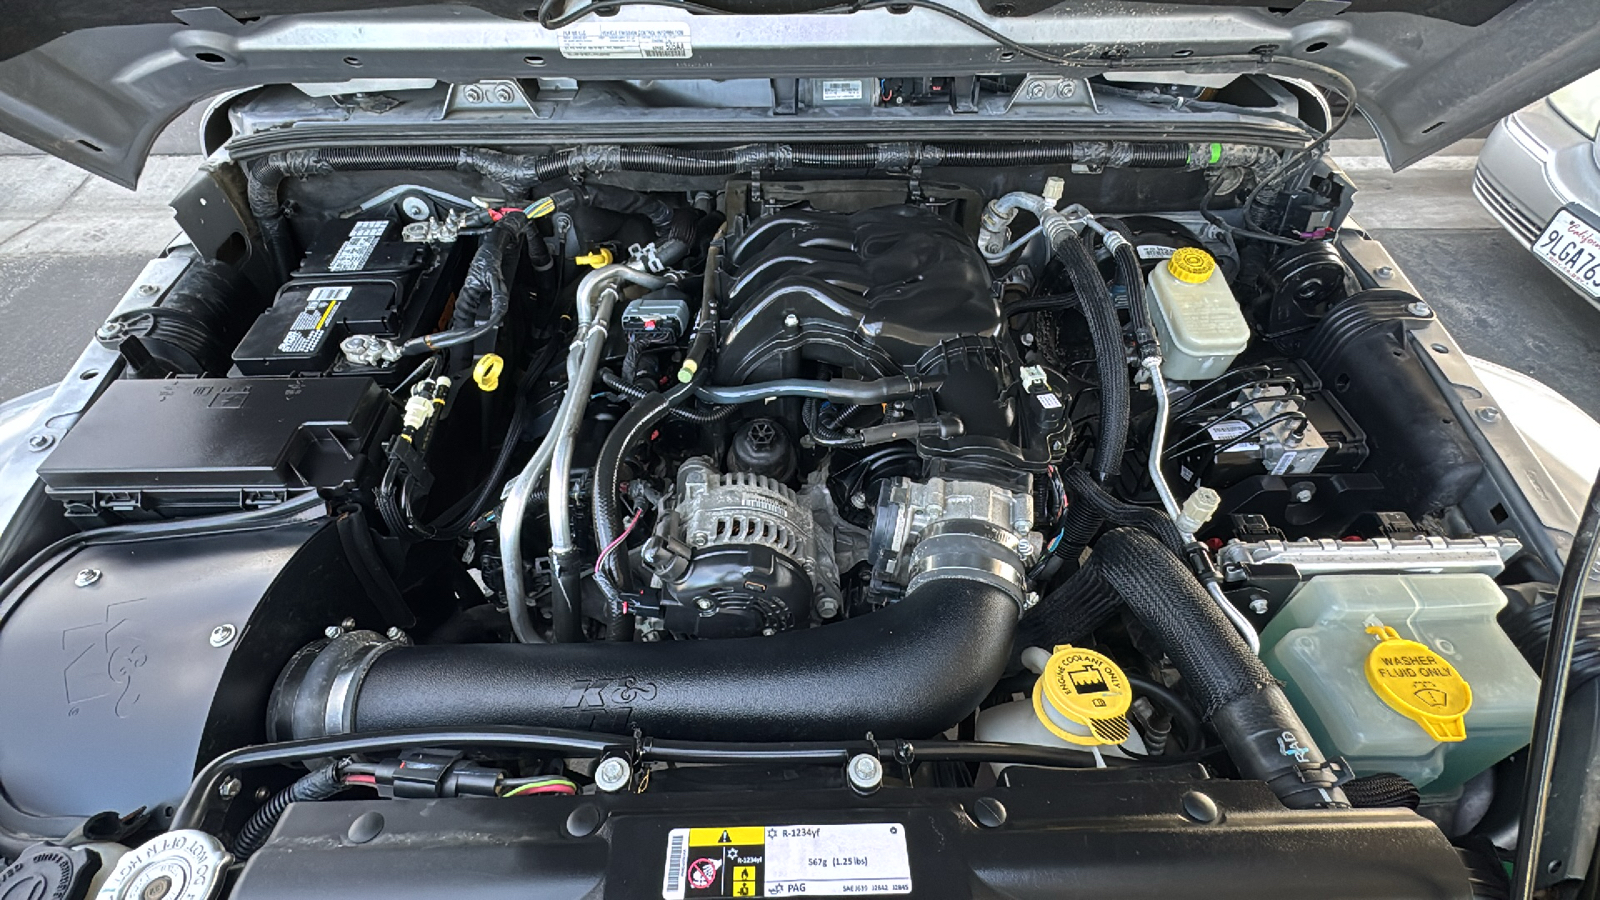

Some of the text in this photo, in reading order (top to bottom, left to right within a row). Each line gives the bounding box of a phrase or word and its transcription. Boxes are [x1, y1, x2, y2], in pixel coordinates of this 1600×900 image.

[1540, 230, 1600, 288] 9LGA76
[1381, 656, 1438, 666] WASHER
[1057, 655, 1121, 695] ENGINE COOLANT ONLY
[1378, 667, 1452, 678] FLUID ONLY
[782, 828, 821, 838] R-1234yf
[808, 856, 868, 868] 567g (1.25 lbs)
[787, 883, 806, 893] PAG
